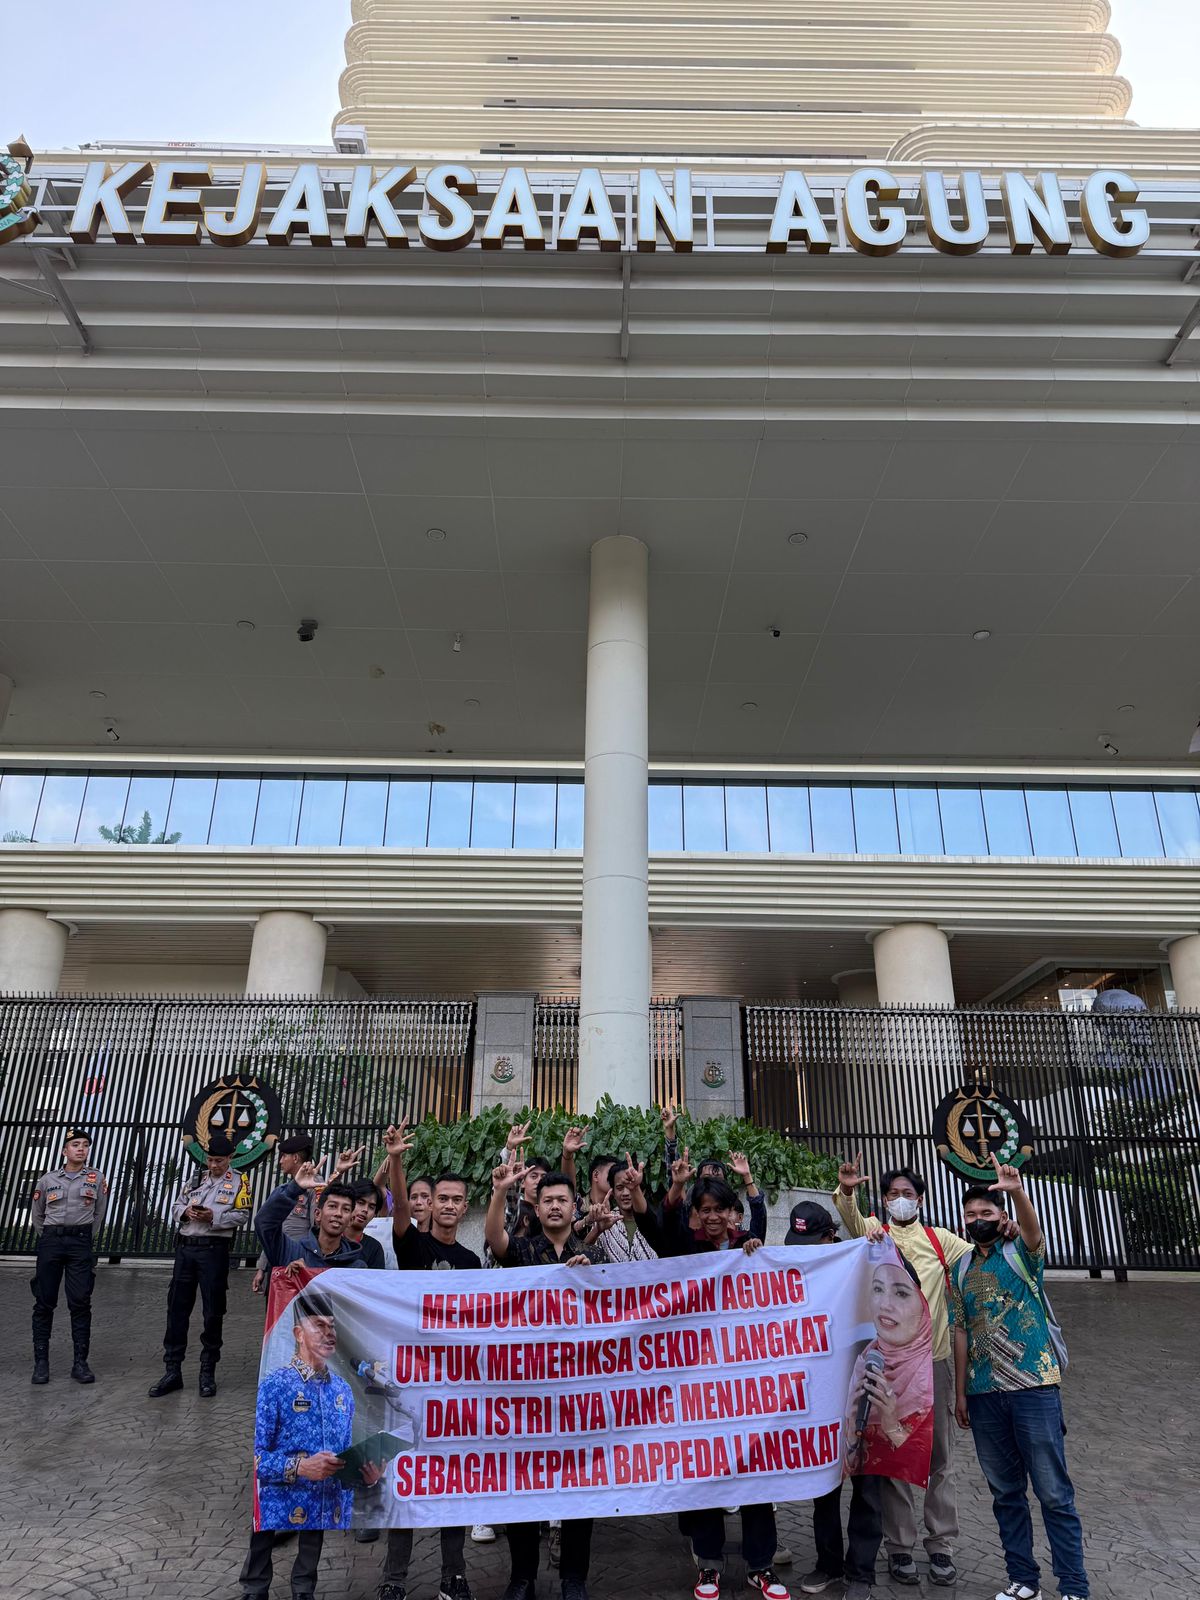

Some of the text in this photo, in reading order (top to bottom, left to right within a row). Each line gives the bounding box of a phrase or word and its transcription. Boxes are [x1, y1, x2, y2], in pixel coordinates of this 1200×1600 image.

[70, 160, 1151, 257] KEJAKSAAN AGUNG
[422, 1268, 805, 1329] MENDUKUNG KEJAKSAAN AGUNG
[396, 1314, 829, 1384] UNTUK MEMERIKSA SEKDA LANGKAT
[426, 1371, 806, 1438] DAN ISTRI NYA YANG MENJABAT
[397, 1422, 840, 1497] SEBAGAI KEPALA BAPPEDA LANGKAT
